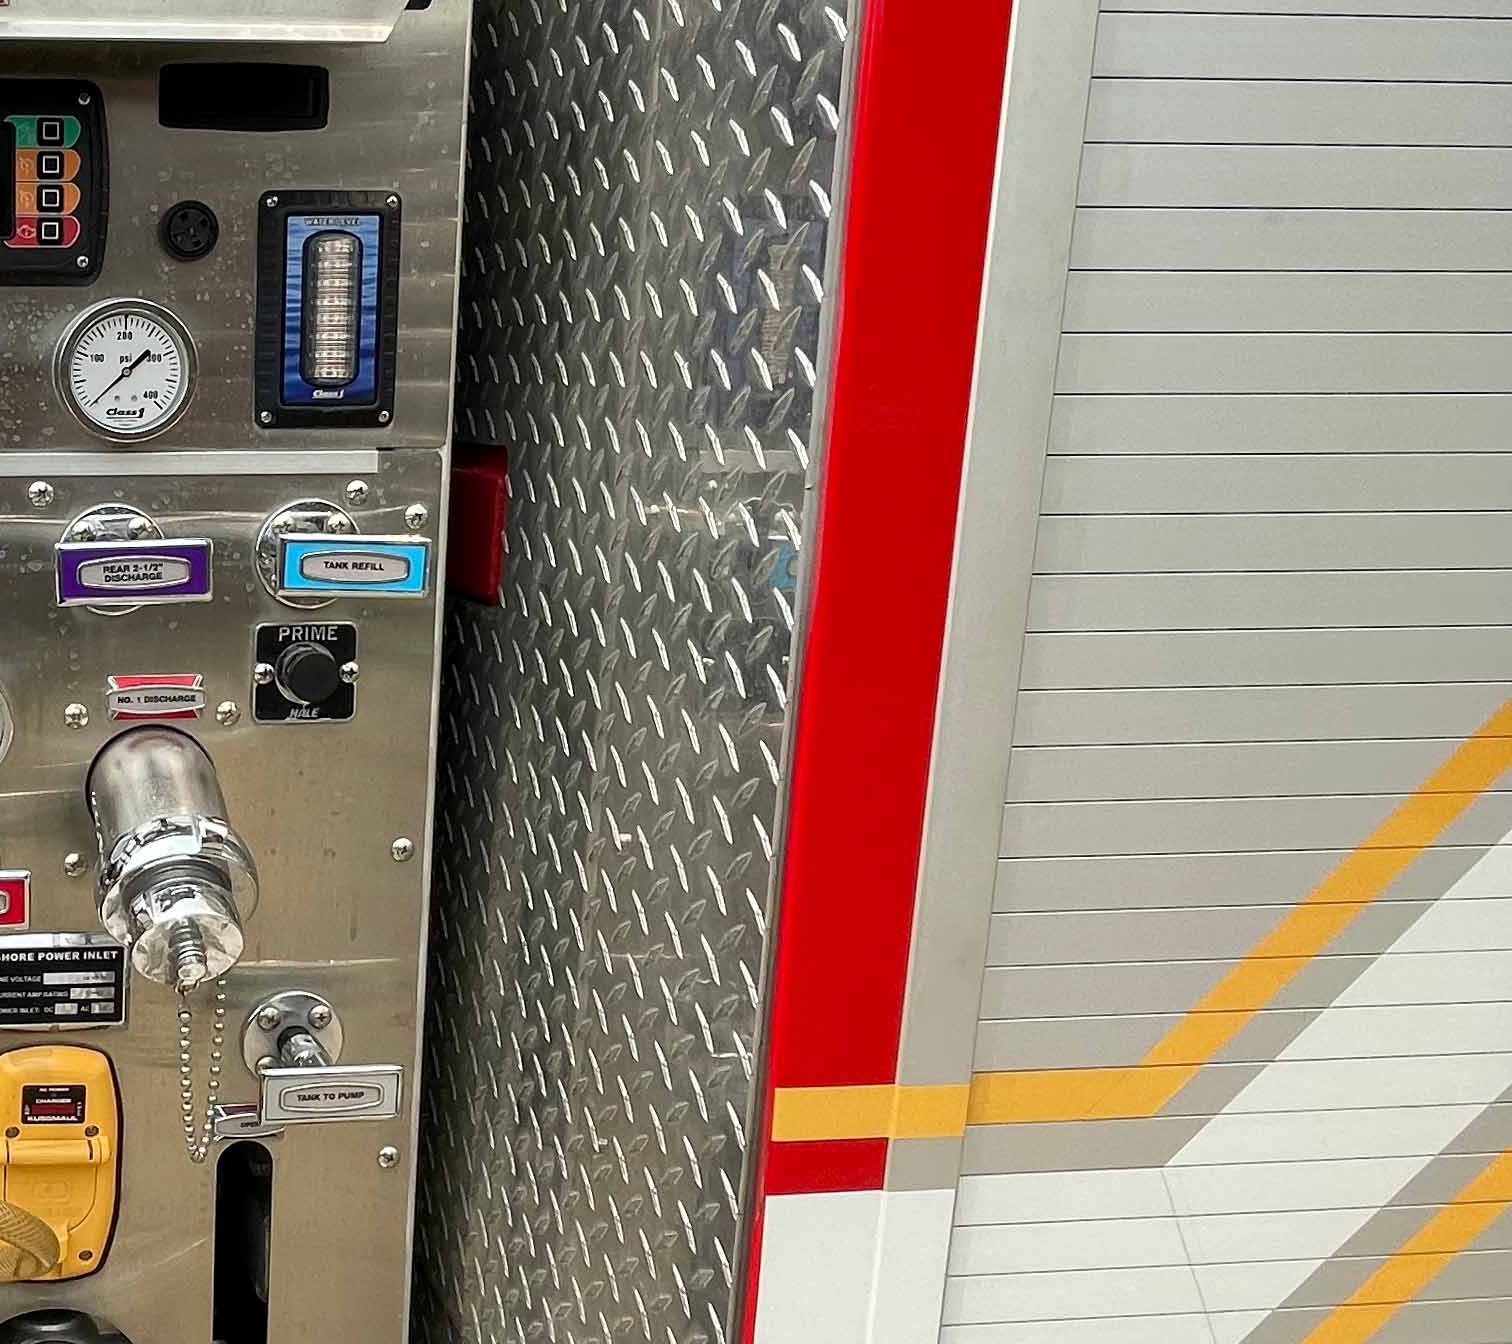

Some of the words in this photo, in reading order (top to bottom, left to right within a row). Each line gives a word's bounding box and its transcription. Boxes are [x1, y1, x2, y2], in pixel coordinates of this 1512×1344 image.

[117, 332, 133, 340] 200
[90, 354, 104, 362] 100
[147, 354, 162, 362] 300
[143, 391, 158, 399] 400
[103, 565, 130, 574] REAR
[323, 561, 349, 570] TANK
[352, 562, 384, 571] REFILL
[104, 572, 163, 582] DISCHARGE
[278, 626, 338, 642] PRIME
[144, 695, 196, 704] DISCHARGE
[289, 707, 320, 718] HALE
[38, 951, 79, 961] POWER
[83, 950, 118, 959] INLET
[297, 1094, 320, 1102] TANK
[338, 1091, 364, 1100] PUMP
